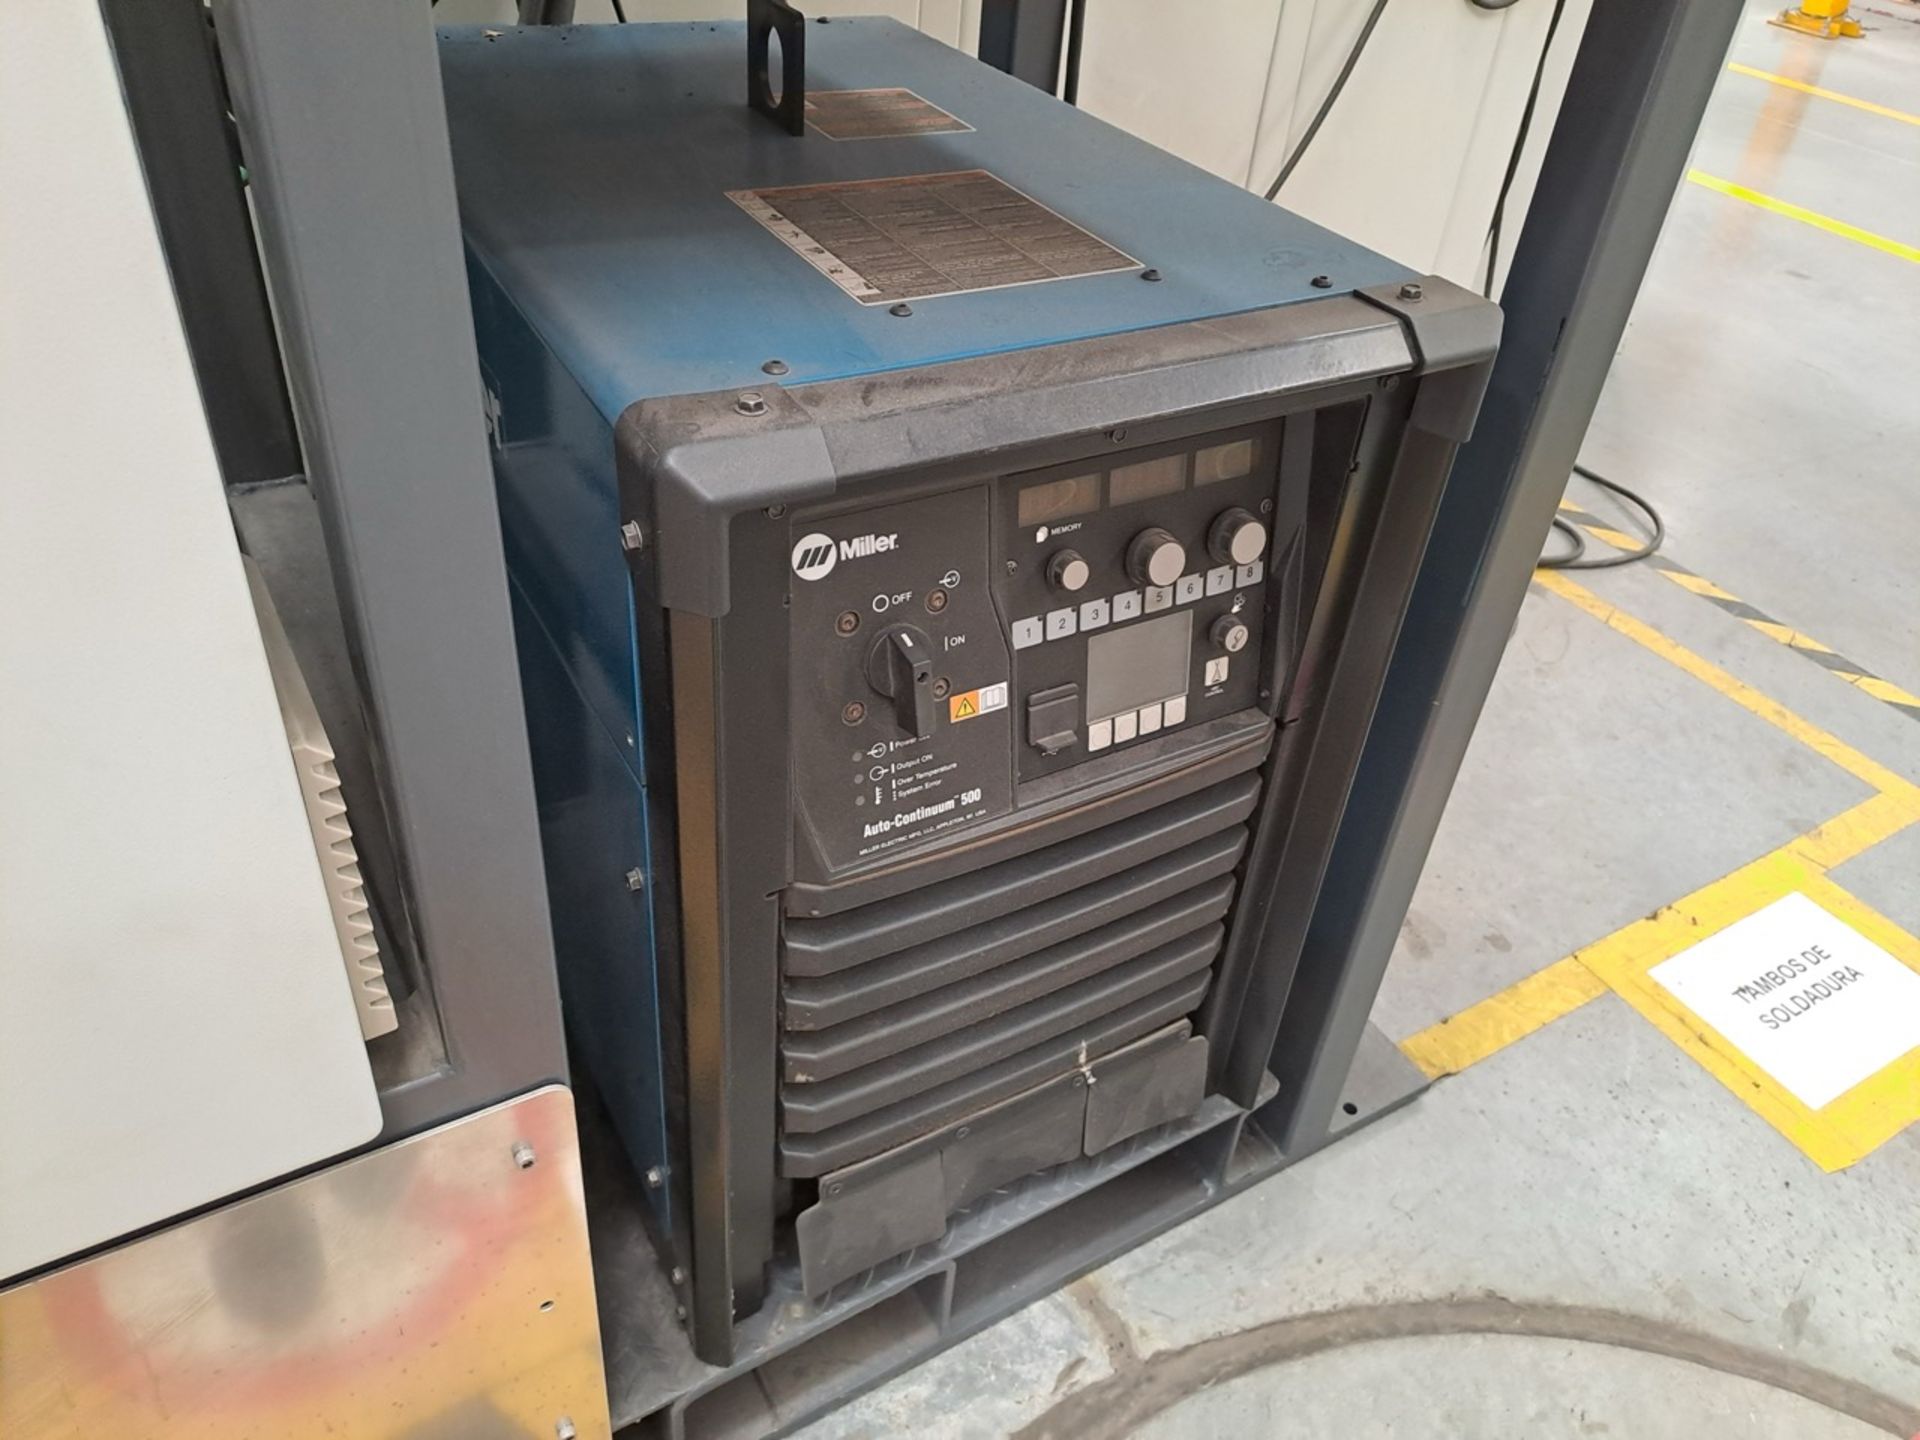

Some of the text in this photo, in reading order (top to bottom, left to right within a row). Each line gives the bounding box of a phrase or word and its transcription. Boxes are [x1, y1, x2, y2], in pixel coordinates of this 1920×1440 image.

[1051, 522, 1082, 536] MEMORY
[839, 533, 899, 561] Miller
[891, 591, 913, 605] OFF
[1026, 567, 1254, 639] 1 2 3 4 5 6 7 8
[949, 634, 966, 647] ON
[896, 754, 933, 770] Output ON
[897, 762, 958, 786] Over Temperature
[898, 779, 942, 798] System Error
[961, 788, 982, 806] 500
[1731, 944, 1832, 1004] TAMBOS DE
[1758, 965, 1865, 1030] SOLDADURA
